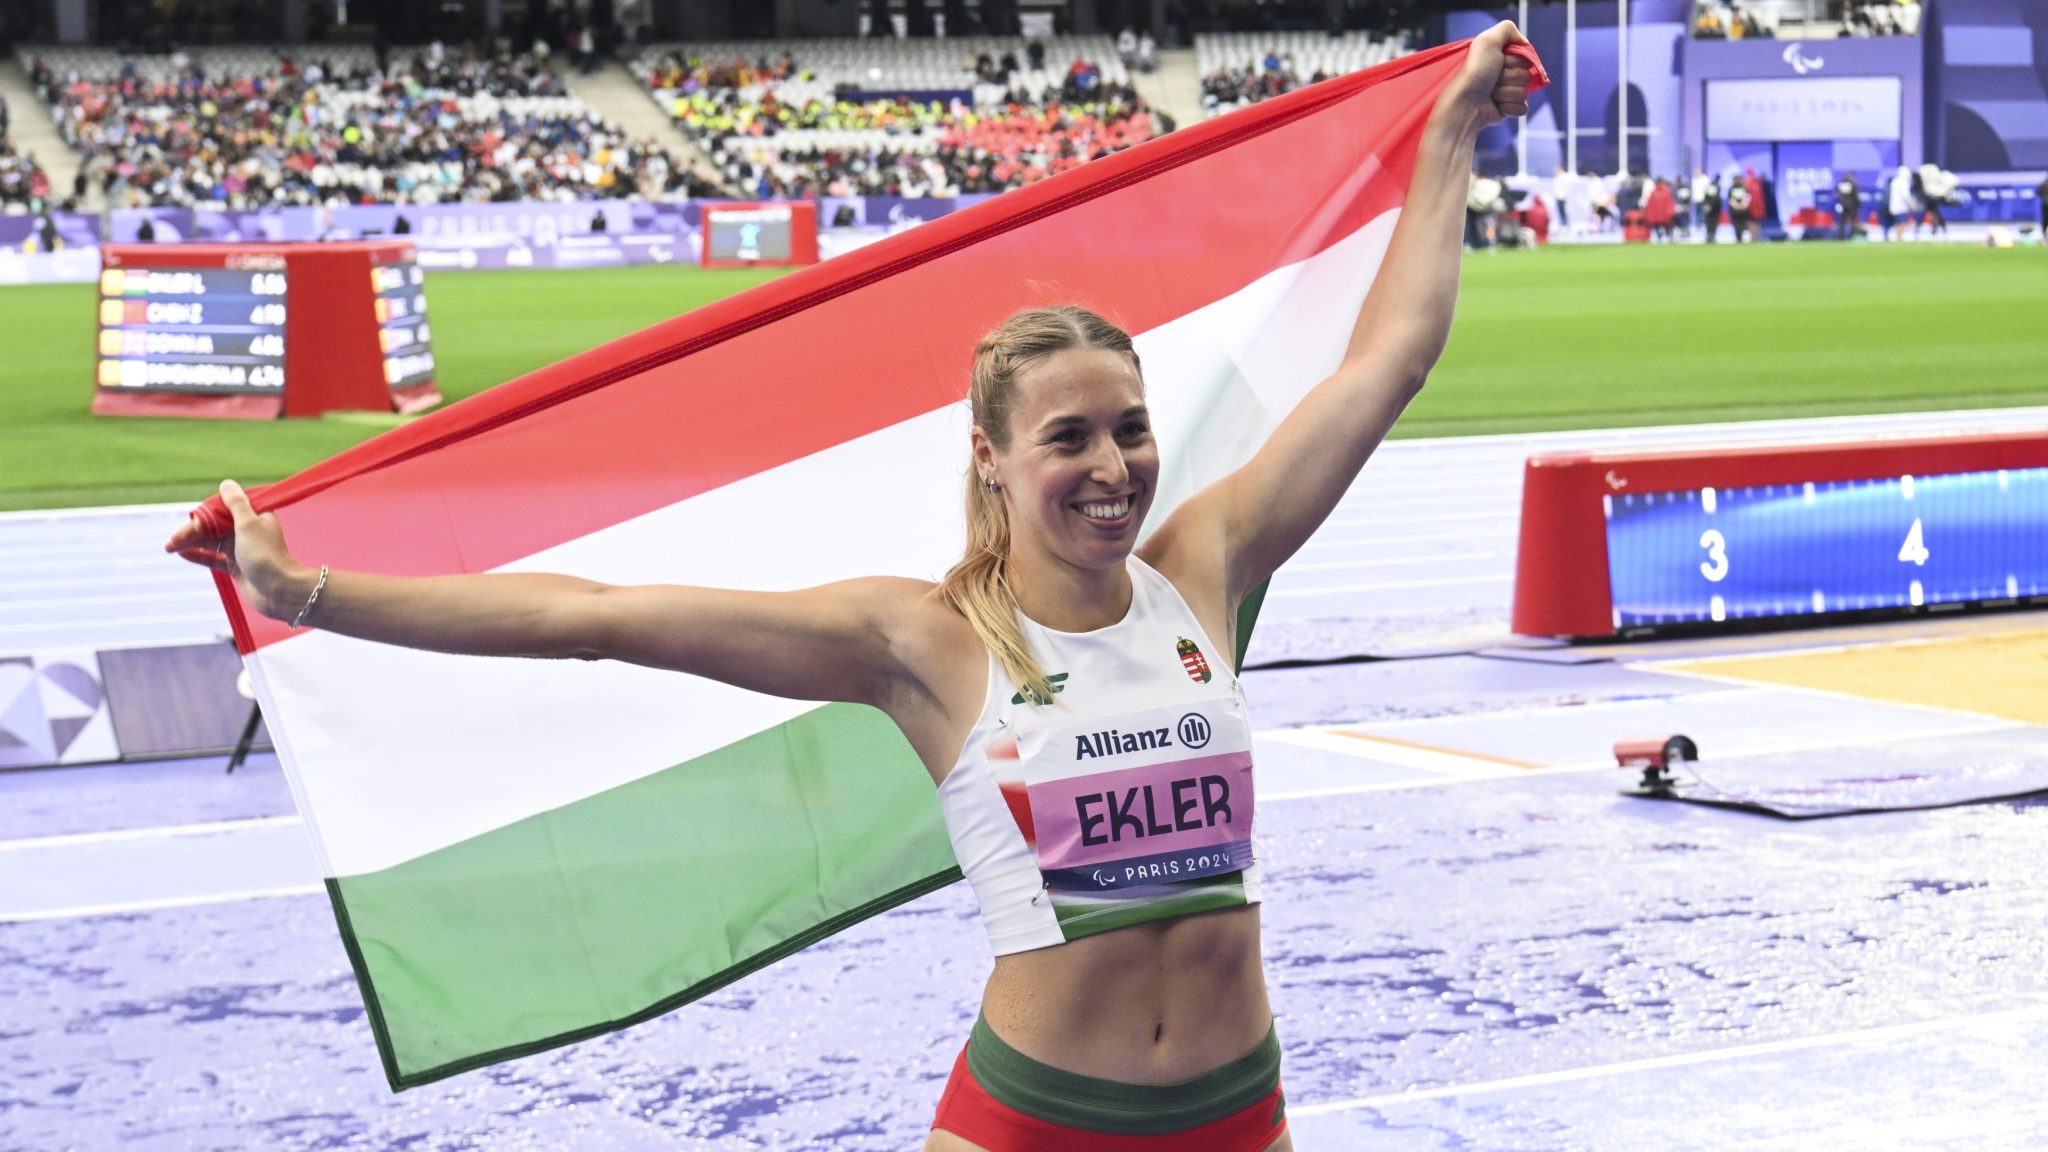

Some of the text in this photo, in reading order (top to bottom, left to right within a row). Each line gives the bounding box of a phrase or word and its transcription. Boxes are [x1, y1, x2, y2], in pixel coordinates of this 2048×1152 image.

[1741, 99, 1799, 115] PARIS
[1700, 529, 1729, 582] 3
[1898, 517, 1929, 566] 4
[1075, 727, 1173, 760] Allianz
[1075, 775, 1232, 847] EKLER
[1125, 852, 1230, 880] PARIS 2024
